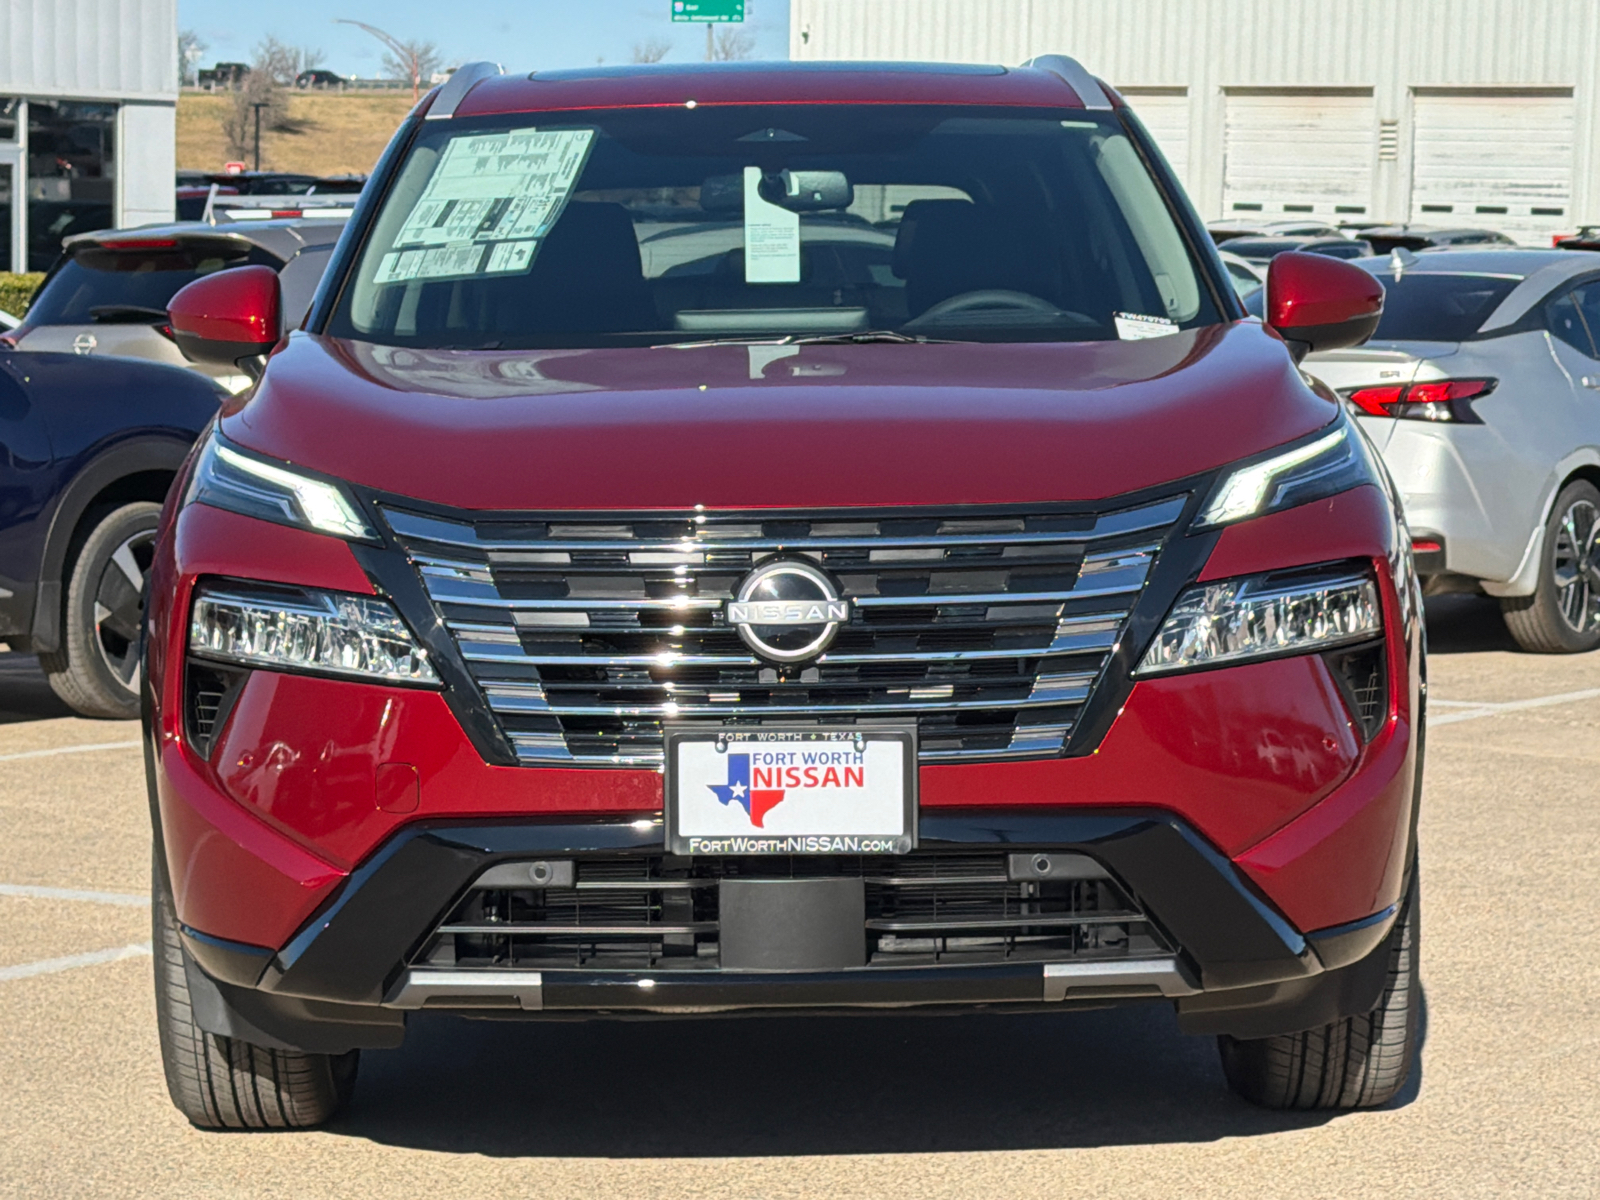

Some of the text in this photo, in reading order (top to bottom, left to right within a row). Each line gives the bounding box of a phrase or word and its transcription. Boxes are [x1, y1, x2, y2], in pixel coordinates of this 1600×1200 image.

[731, 604, 847, 621] NISSAN
[718, 732, 862, 742] FORT WORTH TEXAS
[753, 752, 864, 765] FORT WORTH
[753, 767, 864, 788] NISSAN
